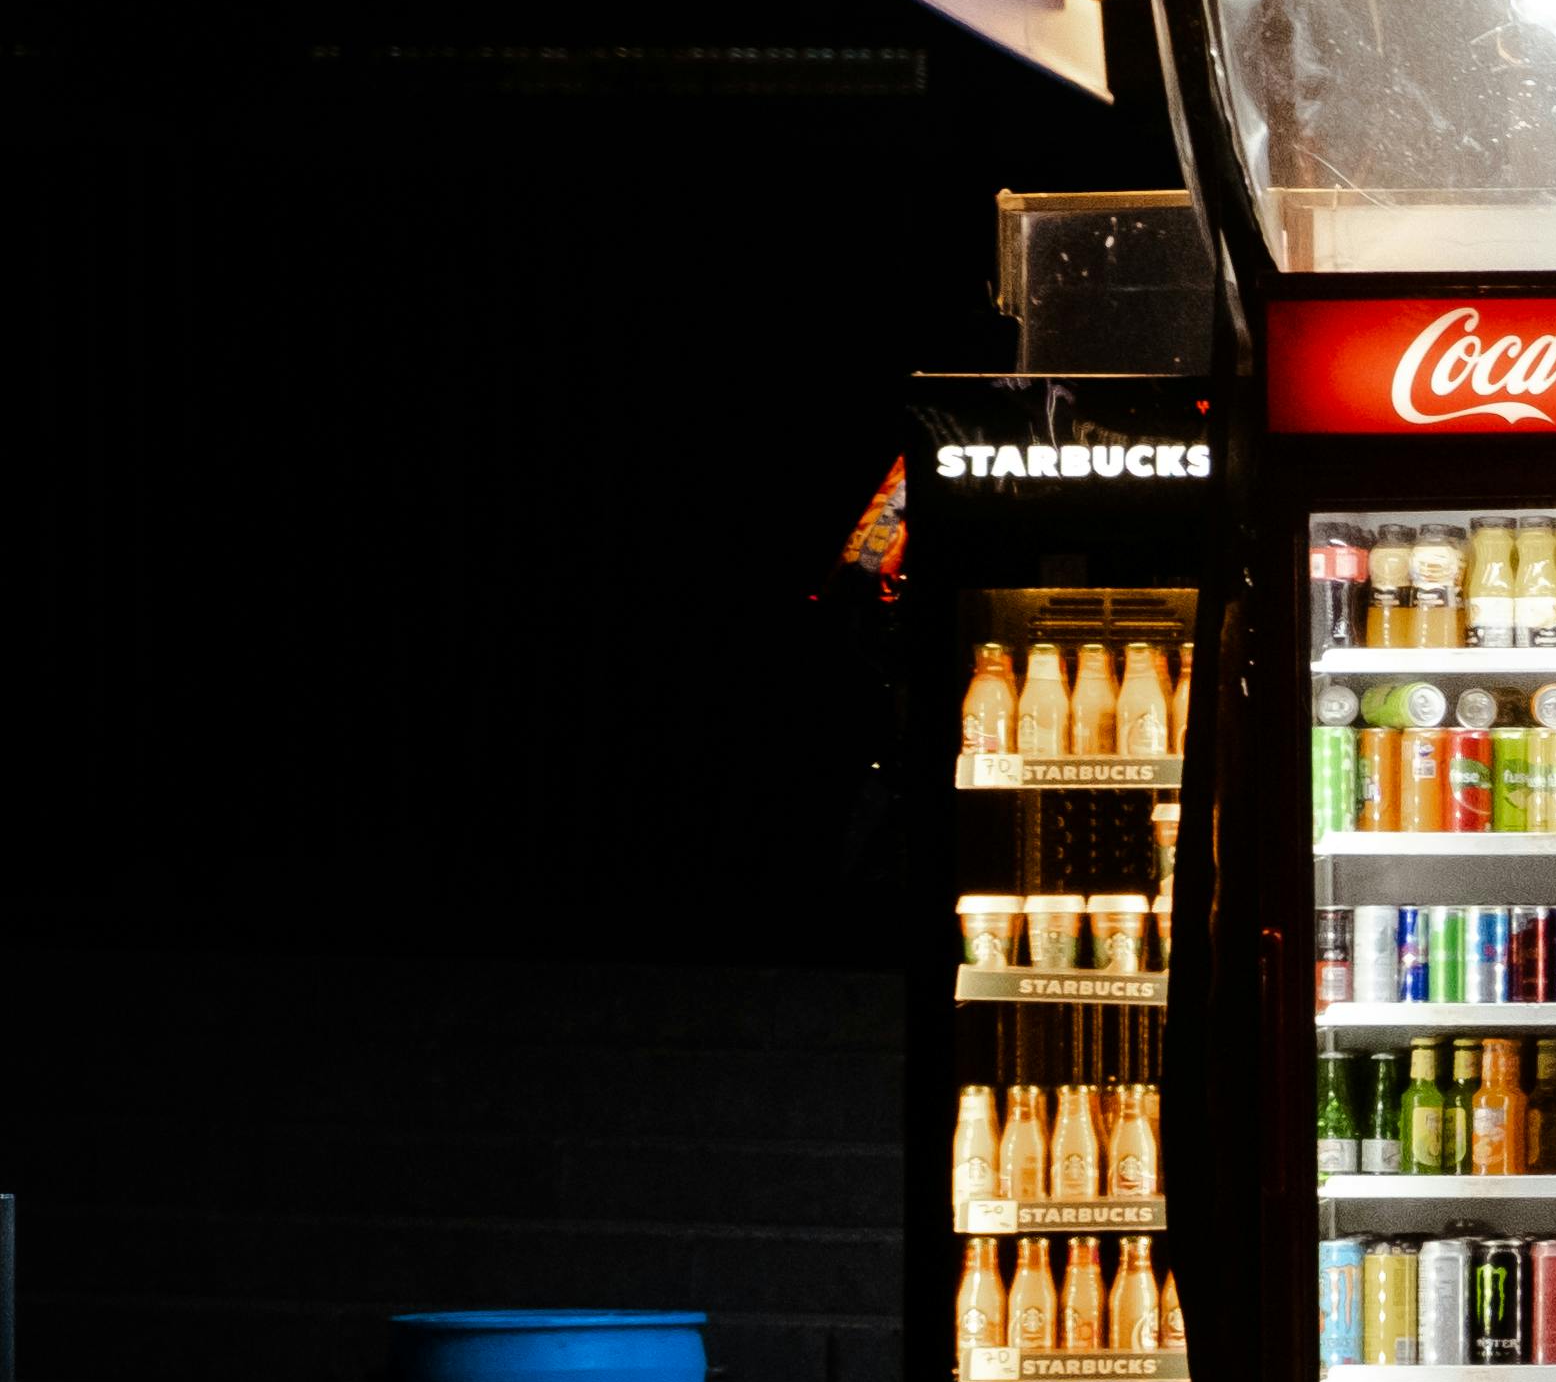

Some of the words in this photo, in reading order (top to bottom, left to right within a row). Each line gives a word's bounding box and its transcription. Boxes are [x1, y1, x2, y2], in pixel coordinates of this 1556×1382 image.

[936, 443, 1211, 478] STARBUCKS
[1023, 765, 1155, 780] STARBUCKS
[1019, 978, 1155, 997] STARBUCKS
[1018, 1206, 1153, 1223] STARBUCKS
[1022, 1358, 1158, 1376] STARBUCKS
